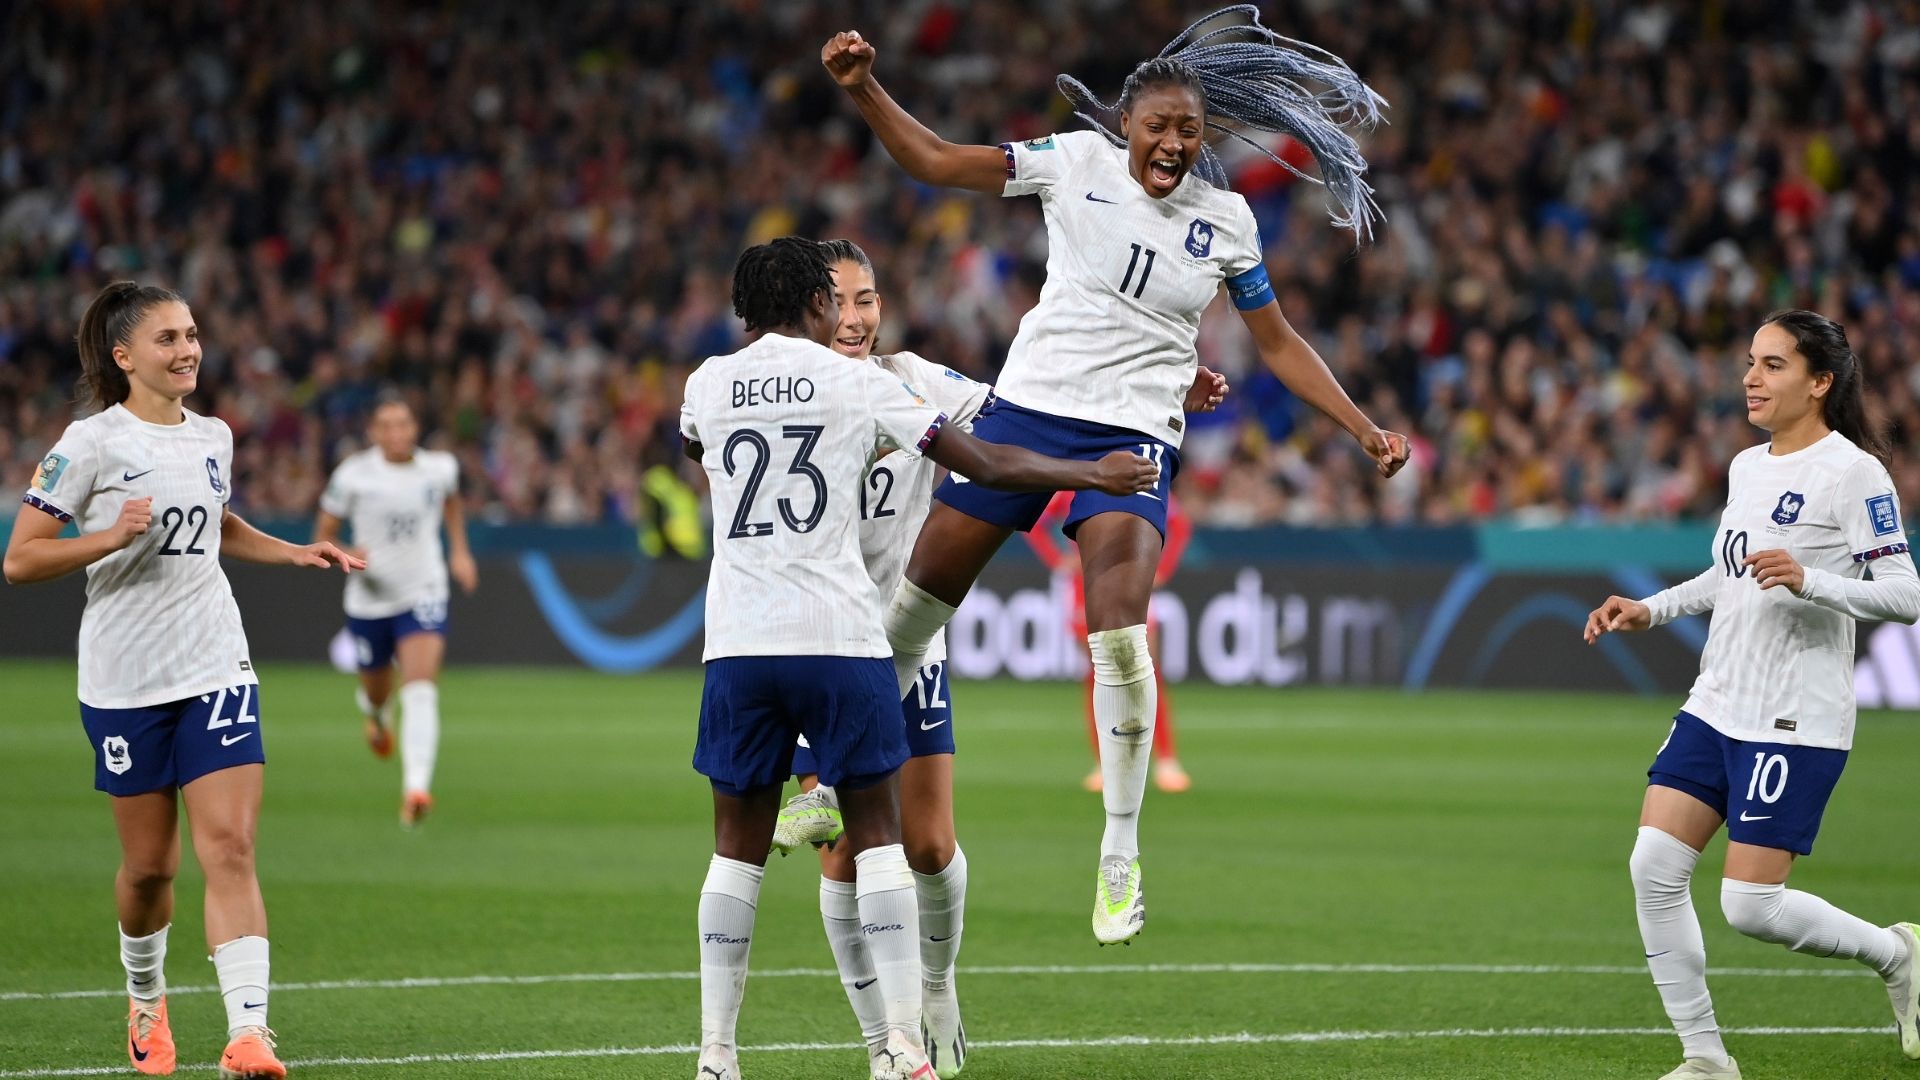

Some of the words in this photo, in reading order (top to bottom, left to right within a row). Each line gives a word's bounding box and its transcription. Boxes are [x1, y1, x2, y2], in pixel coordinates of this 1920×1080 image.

[1119, 243, 1156, 299] 11
[732, 377, 815, 408] BECHO
[723, 425, 828, 539] 23
[861, 466, 896, 520] 12
[158, 505, 208, 556] 22
[1722, 529, 1748, 579] 10
[200, 684, 257, 730] 22
[915, 661, 947, 710] 12
[1746, 751, 1789, 804] 10
